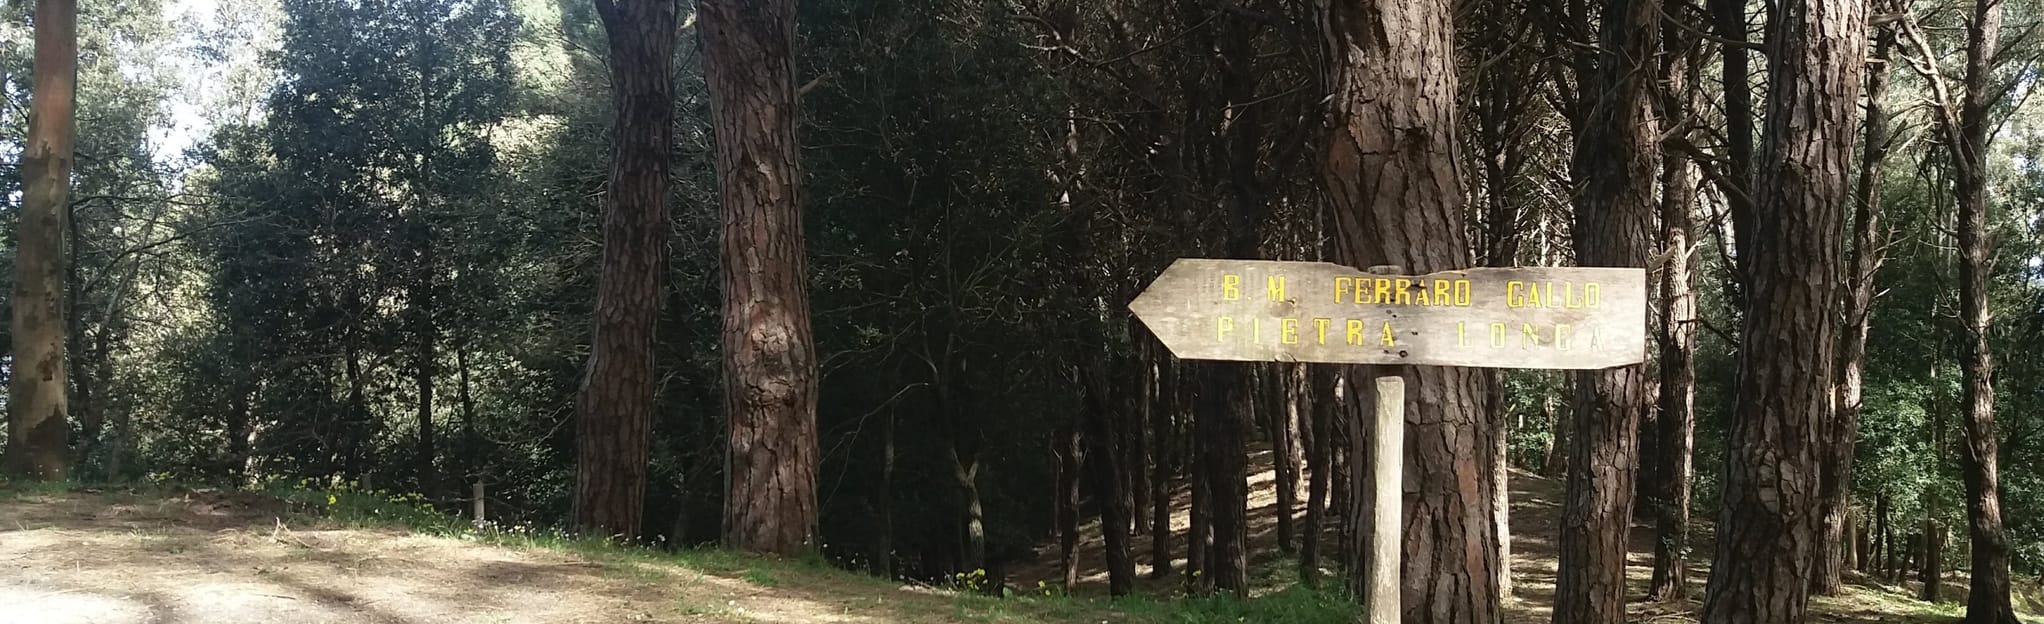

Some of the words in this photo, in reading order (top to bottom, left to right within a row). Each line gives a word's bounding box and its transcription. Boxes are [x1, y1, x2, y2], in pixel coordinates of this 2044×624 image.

[1334, 277, 1471, 307] FERRARO
[1506, 280, 1600, 309] GALLO
[1217, 316, 1395, 348] PIETRA
[1457, 321, 1601, 351] LONGA
